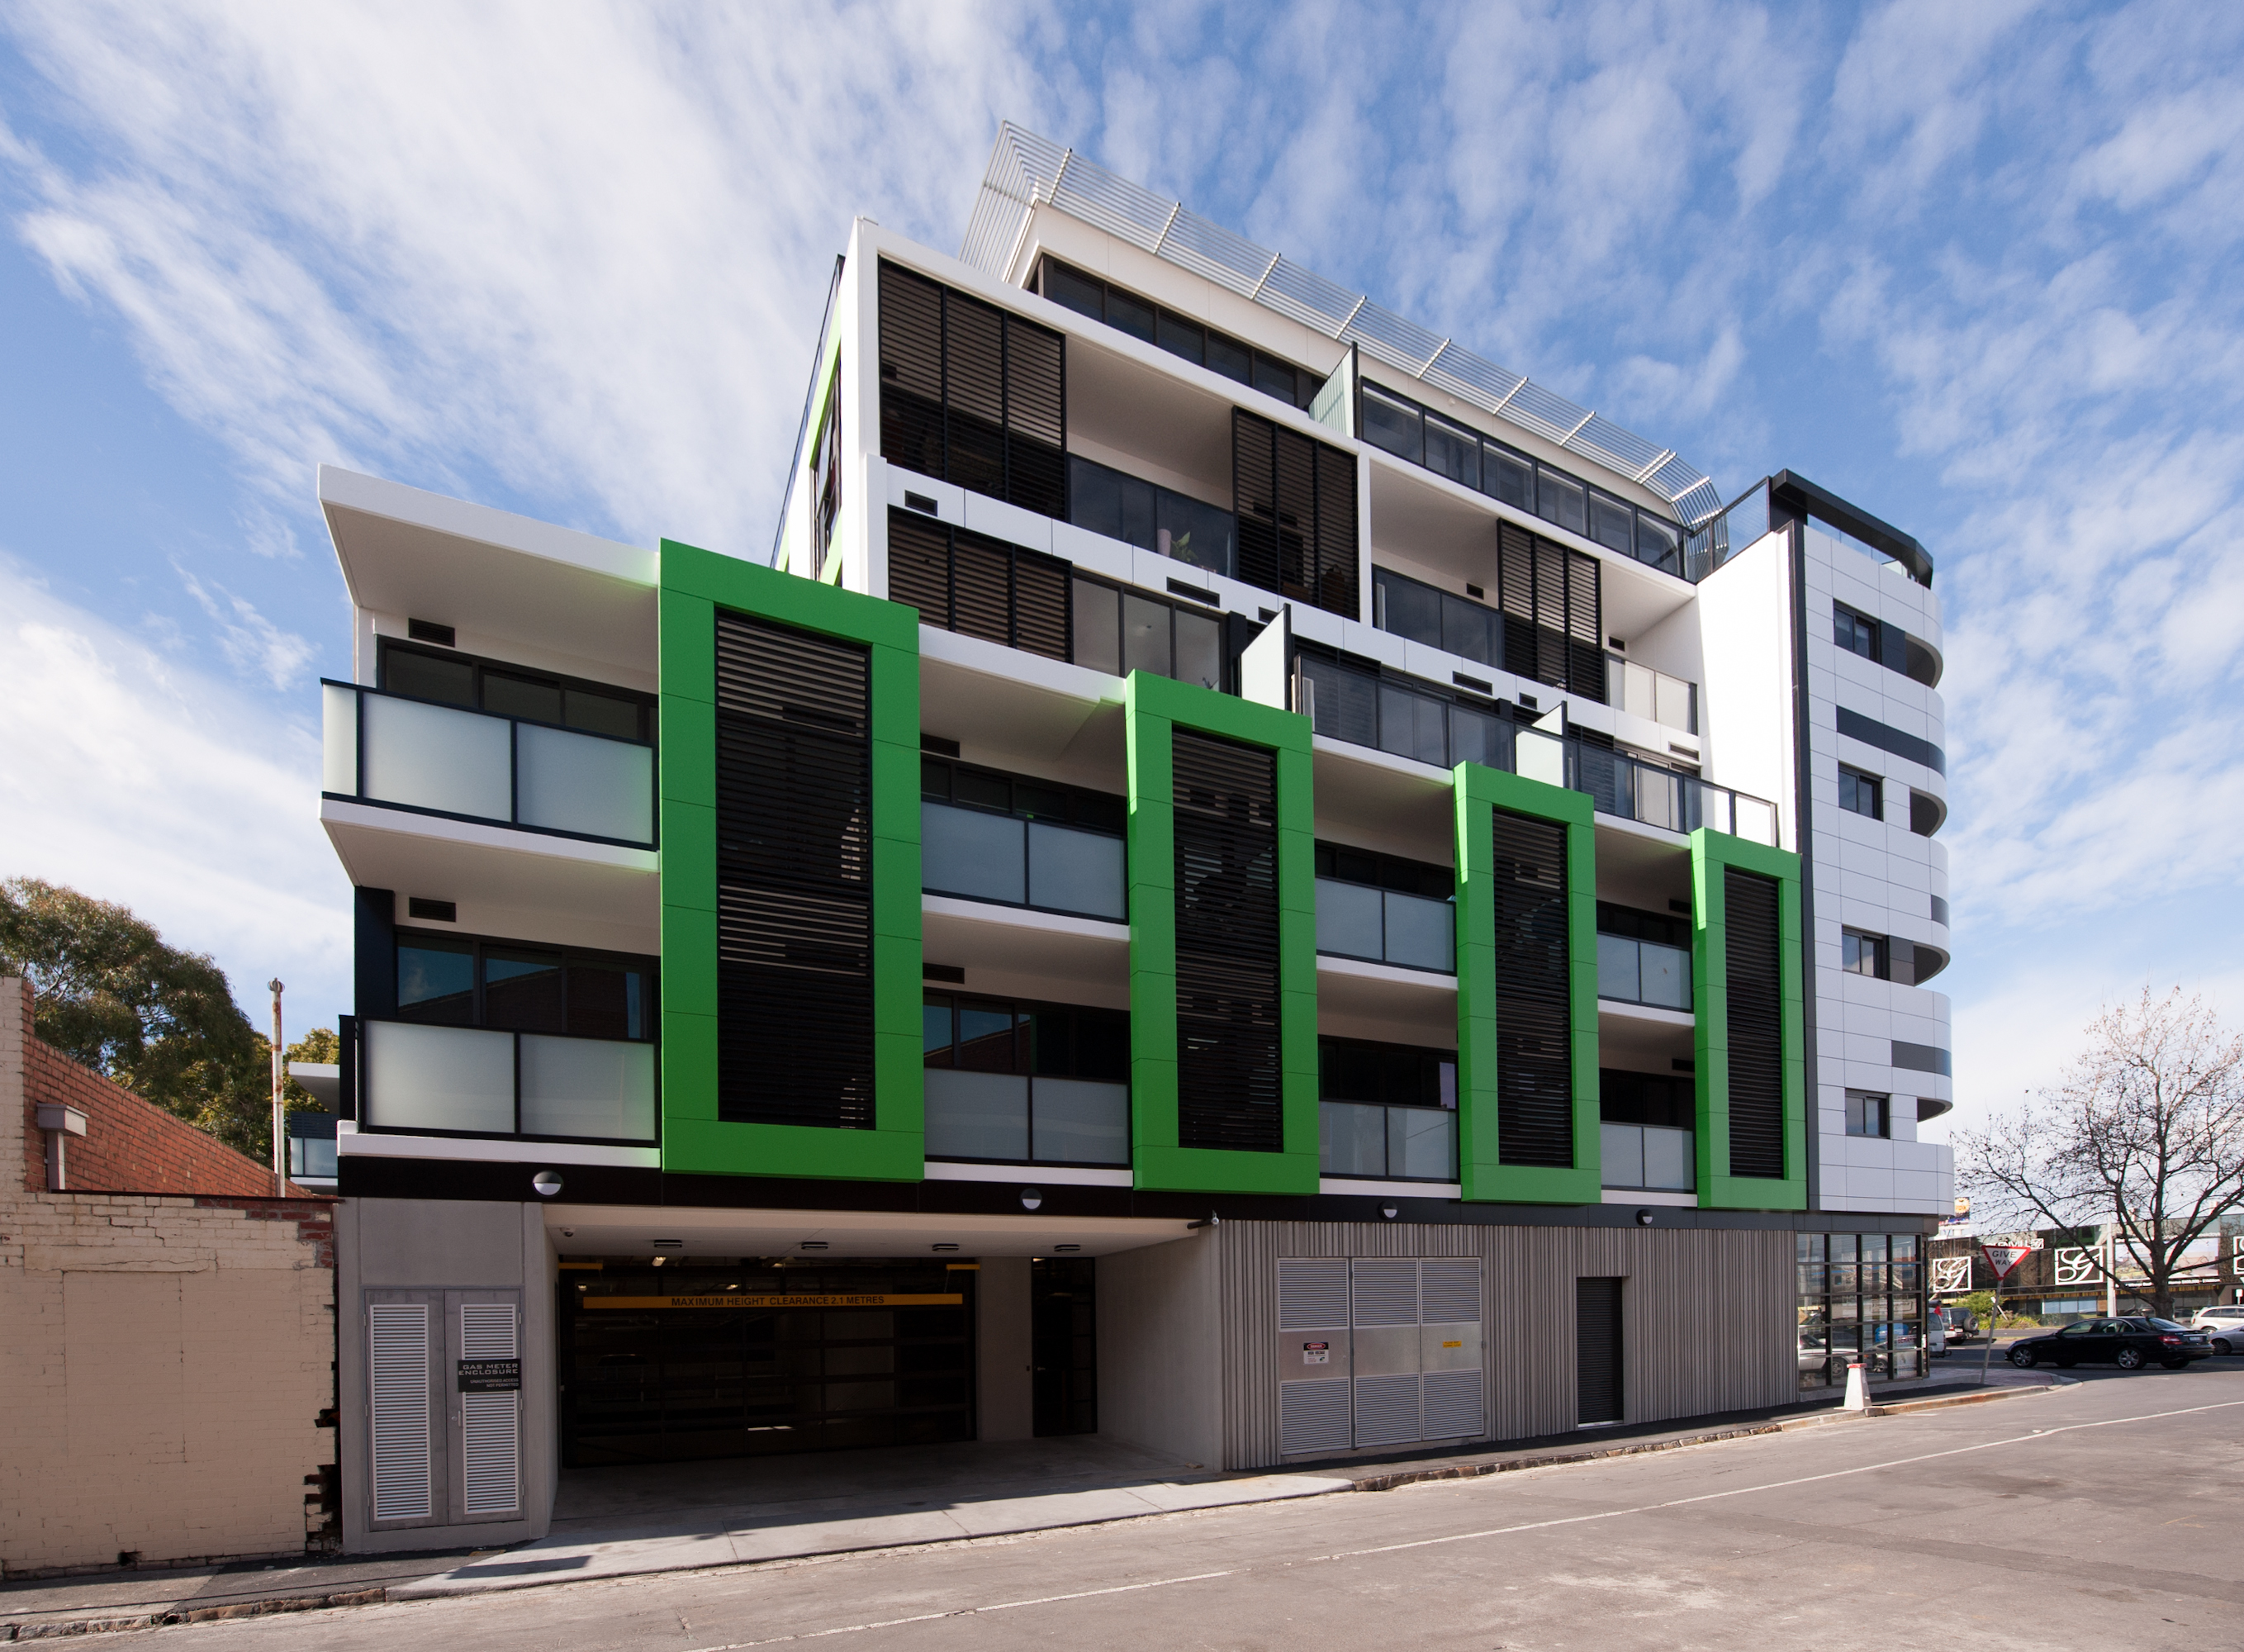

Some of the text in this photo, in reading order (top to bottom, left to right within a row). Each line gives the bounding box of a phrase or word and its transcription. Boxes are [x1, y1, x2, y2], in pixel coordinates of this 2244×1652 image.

[1992, 1250, 2017, 1258] GIVE
[671, 1298, 723, 1306] MAXIMUM
[727, 1297, 765, 1306] HEIGHT
[769, 1296, 829, 1305] CLEARANCE
[847, 1296, 885, 1304] METRES
